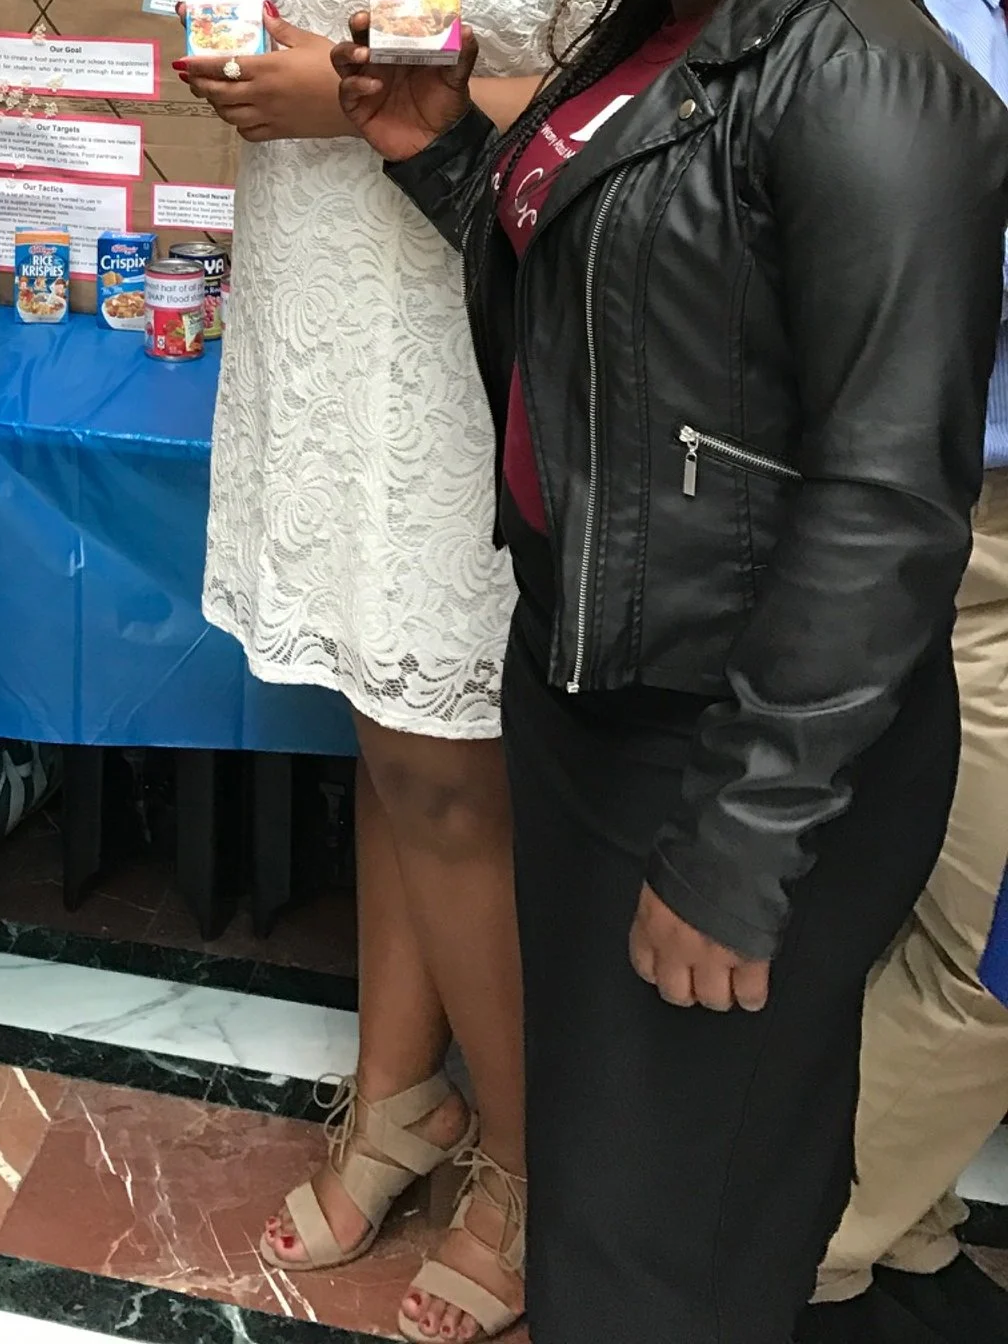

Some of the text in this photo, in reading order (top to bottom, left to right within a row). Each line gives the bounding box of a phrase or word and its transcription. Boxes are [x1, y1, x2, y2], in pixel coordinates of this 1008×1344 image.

[52, 125, 80, 134] Targets
[23, 183, 64, 194] Our Tactics
[32, 256, 53, 265] RICE
[101, 254, 146, 272] Crispix
[22, 265, 63, 277] KRISPIES
[179, 285, 188, 293] of
